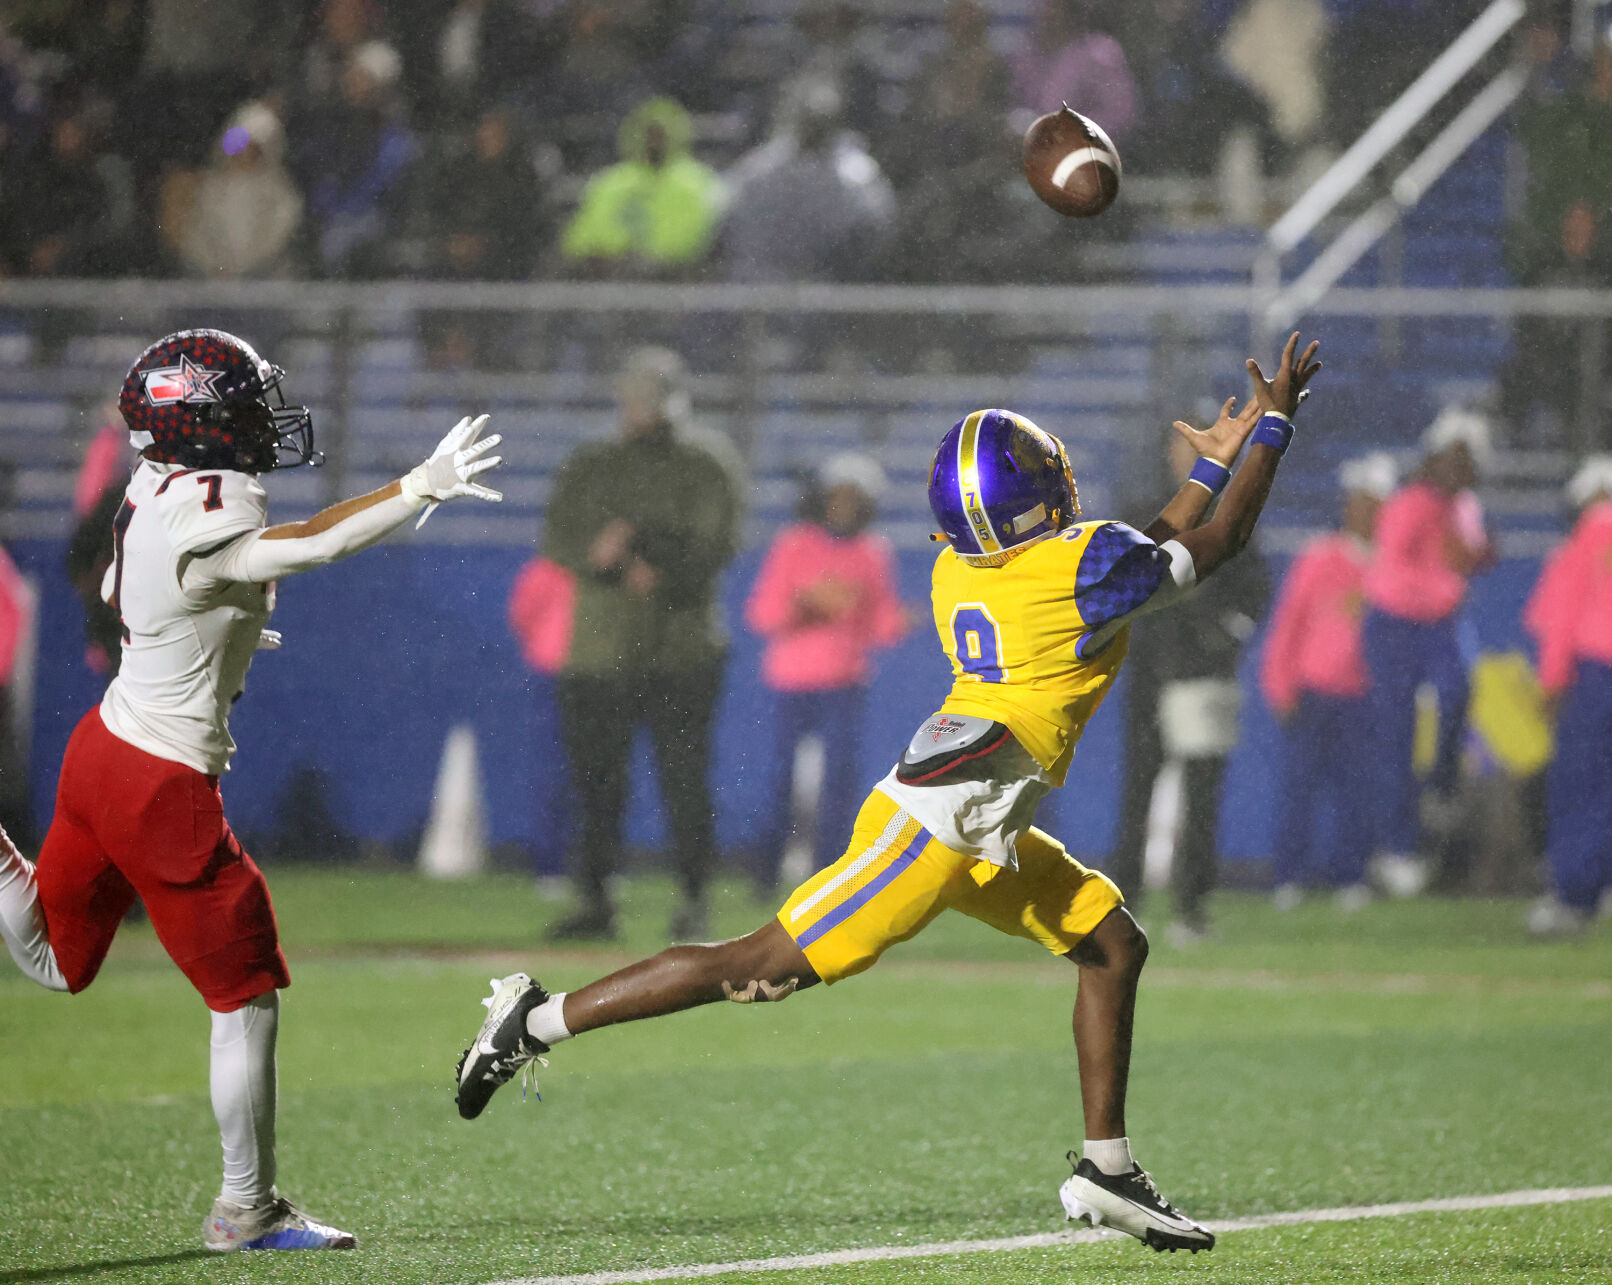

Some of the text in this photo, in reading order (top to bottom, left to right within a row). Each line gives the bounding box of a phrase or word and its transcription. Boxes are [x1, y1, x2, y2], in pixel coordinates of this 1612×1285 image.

[197, 474, 223, 512] 7
[966, 492, 990, 541] 705
[950, 602, 1009, 684] 9
